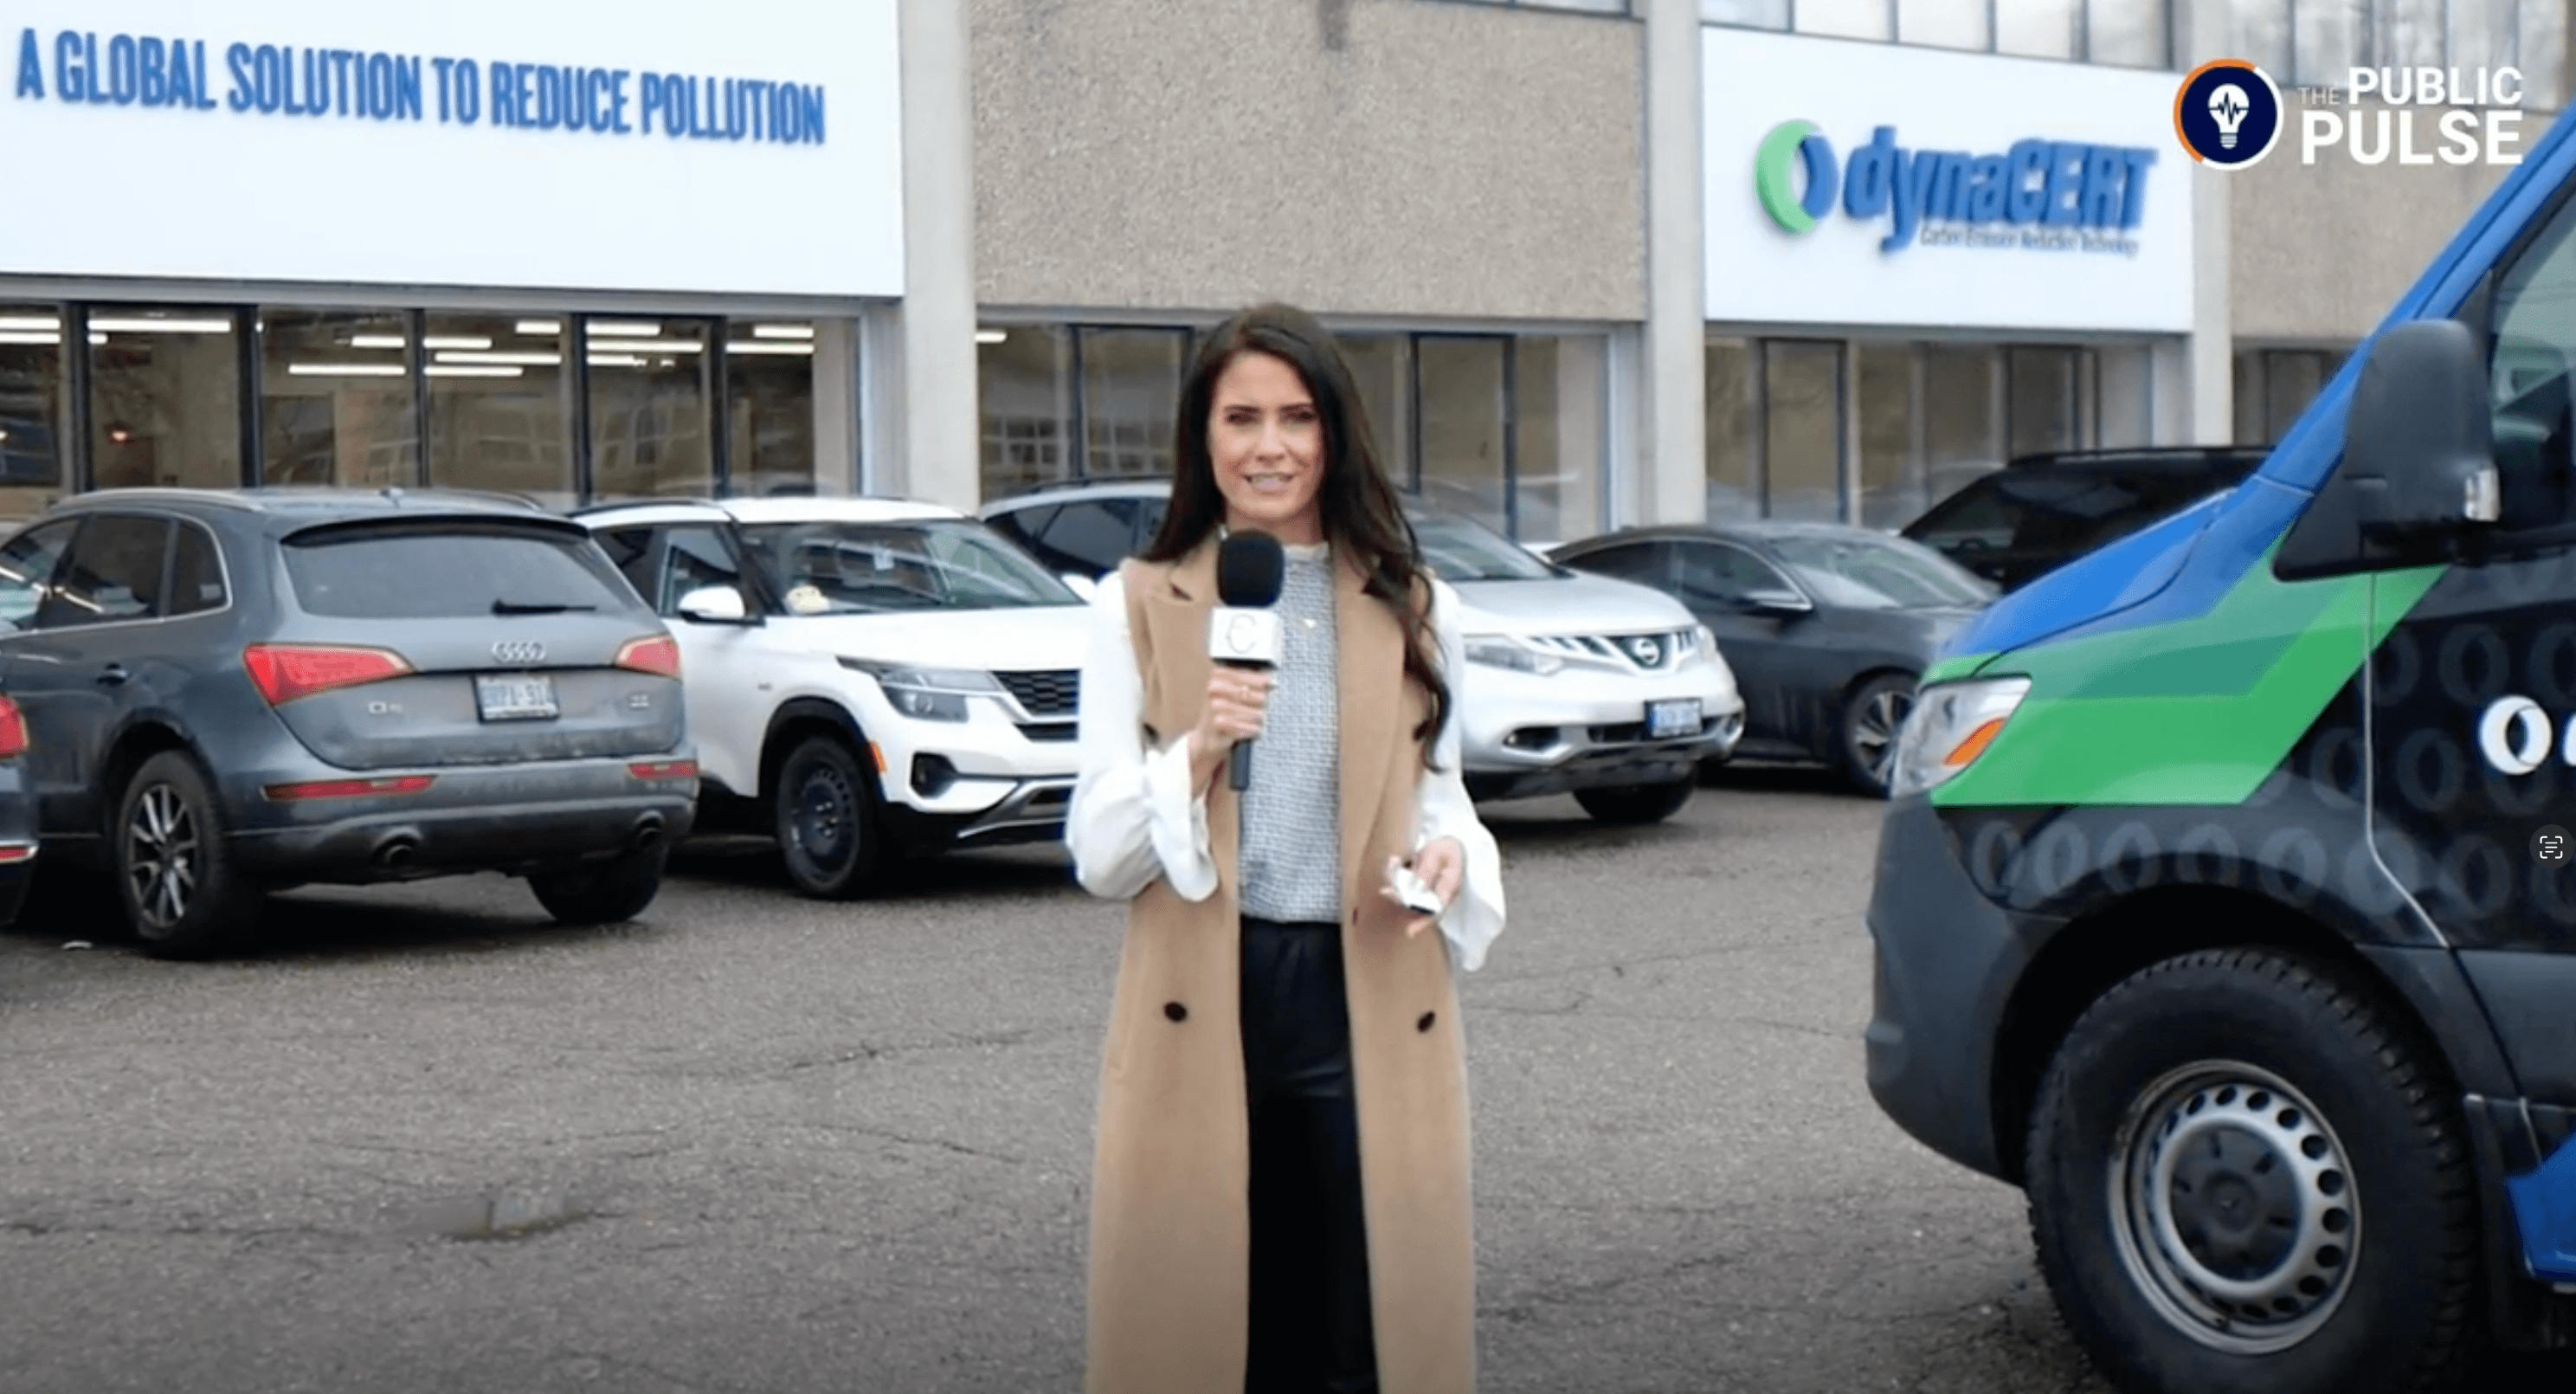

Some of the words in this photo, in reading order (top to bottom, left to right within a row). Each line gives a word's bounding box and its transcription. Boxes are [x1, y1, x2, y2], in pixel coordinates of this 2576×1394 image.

[15, 27, 46, 100] A
[54, 29, 217, 113] GLOBAL
[225, 41, 423, 122] SOLUTION
[432, 55, 480, 126] TO
[490, 60, 633, 136] REDUCE
[639, 71, 826, 145] POLLUTION
[1842, 126, 2160, 255] dynaCERT
